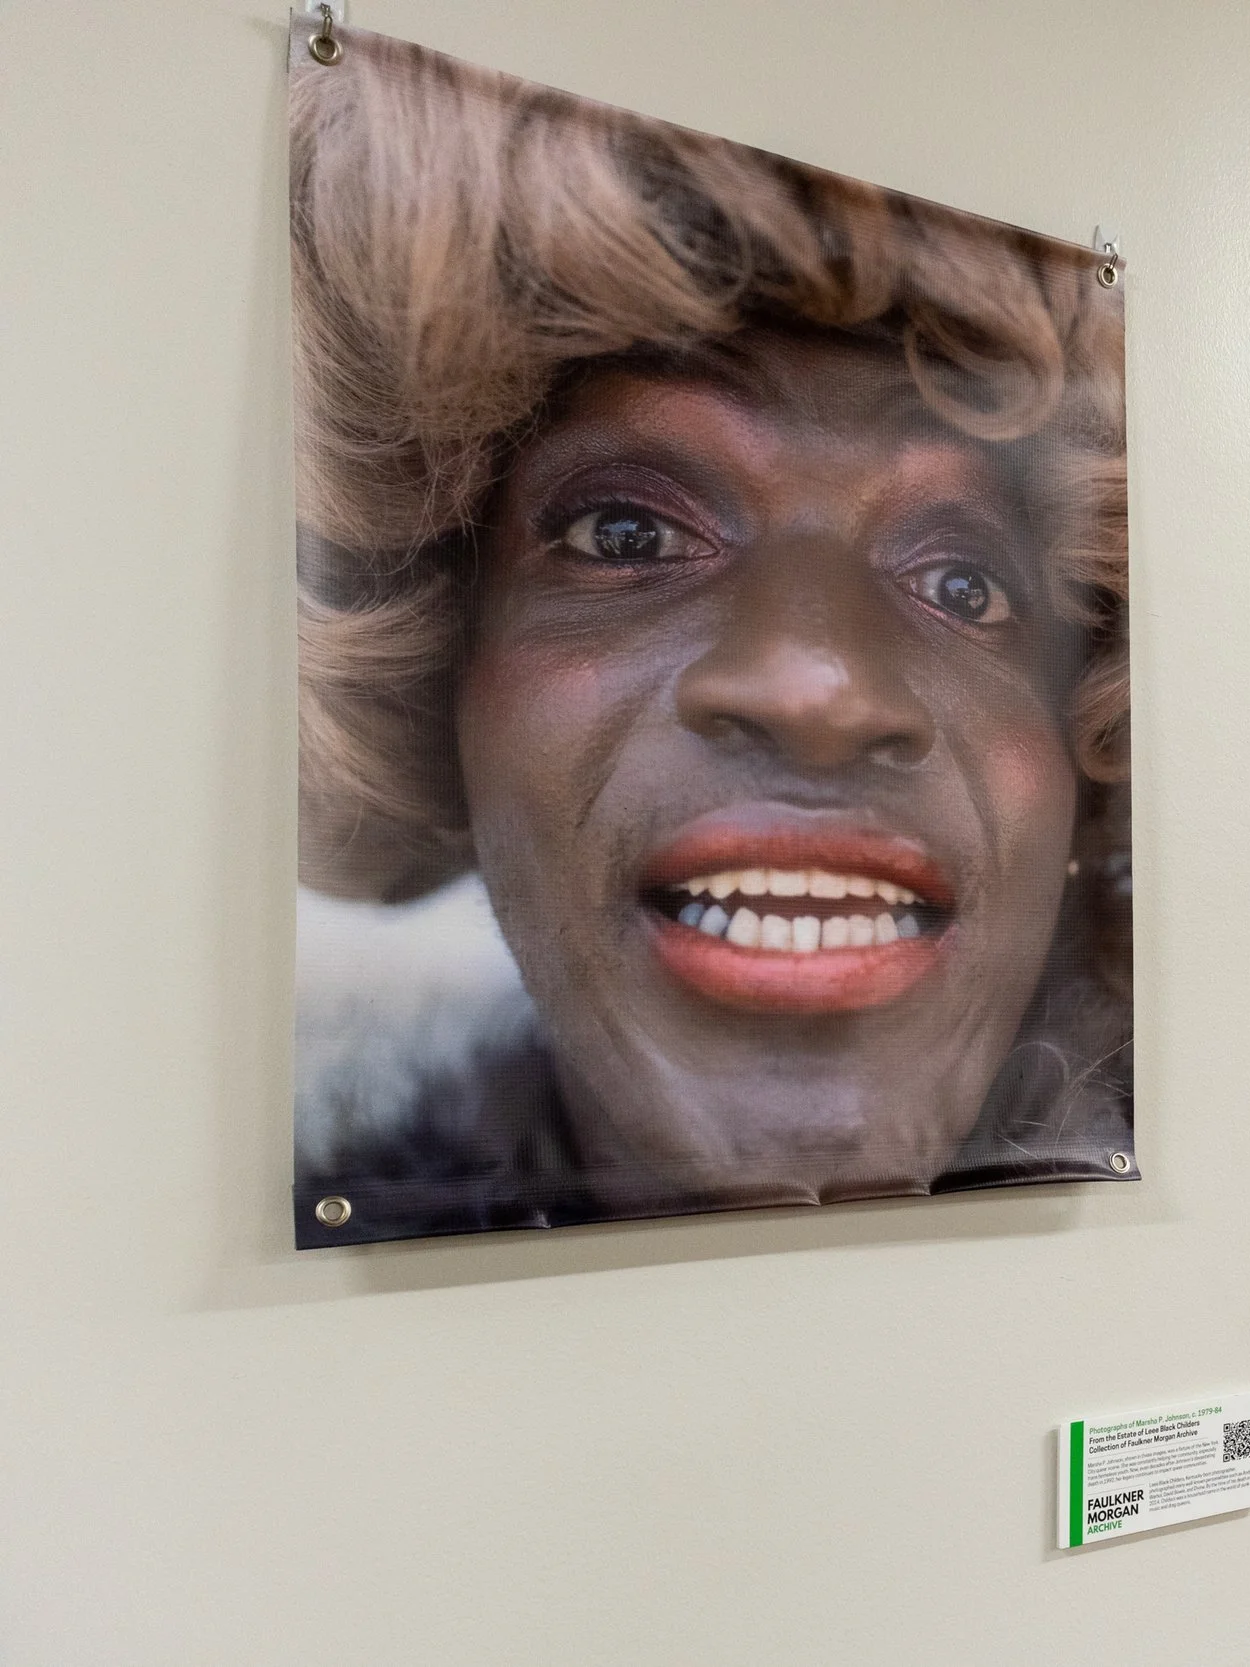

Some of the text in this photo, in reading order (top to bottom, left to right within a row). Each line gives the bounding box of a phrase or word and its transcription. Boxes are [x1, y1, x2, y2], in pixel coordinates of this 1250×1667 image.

[1089, 1423, 1127, 1434] Photographs
[1136, 1418, 1157, 1427] Marsha
[1198, 1406, 1222, 1416] 1979-84
[1117, 1432, 1137, 1440] Estate
[1138, 1428, 1144, 1436] of
[1160, 1423, 1175, 1432] Black
[1177, 1420, 1200, 1429] Childers
[1089, 1444, 1119, 1454] Collection
[1128, 1438, 1152, 1447] Faulkner
[1154, 1434, 1175, 1442] Morgan
[1177, 1430, 1198, 1438] Archive
[1088, 1490, 1144, 1511] FAULKNER
[1088, 1504, 1138, 1524] MORGAN
[1088, 1520, 1122, 1535] ARCHIVE
